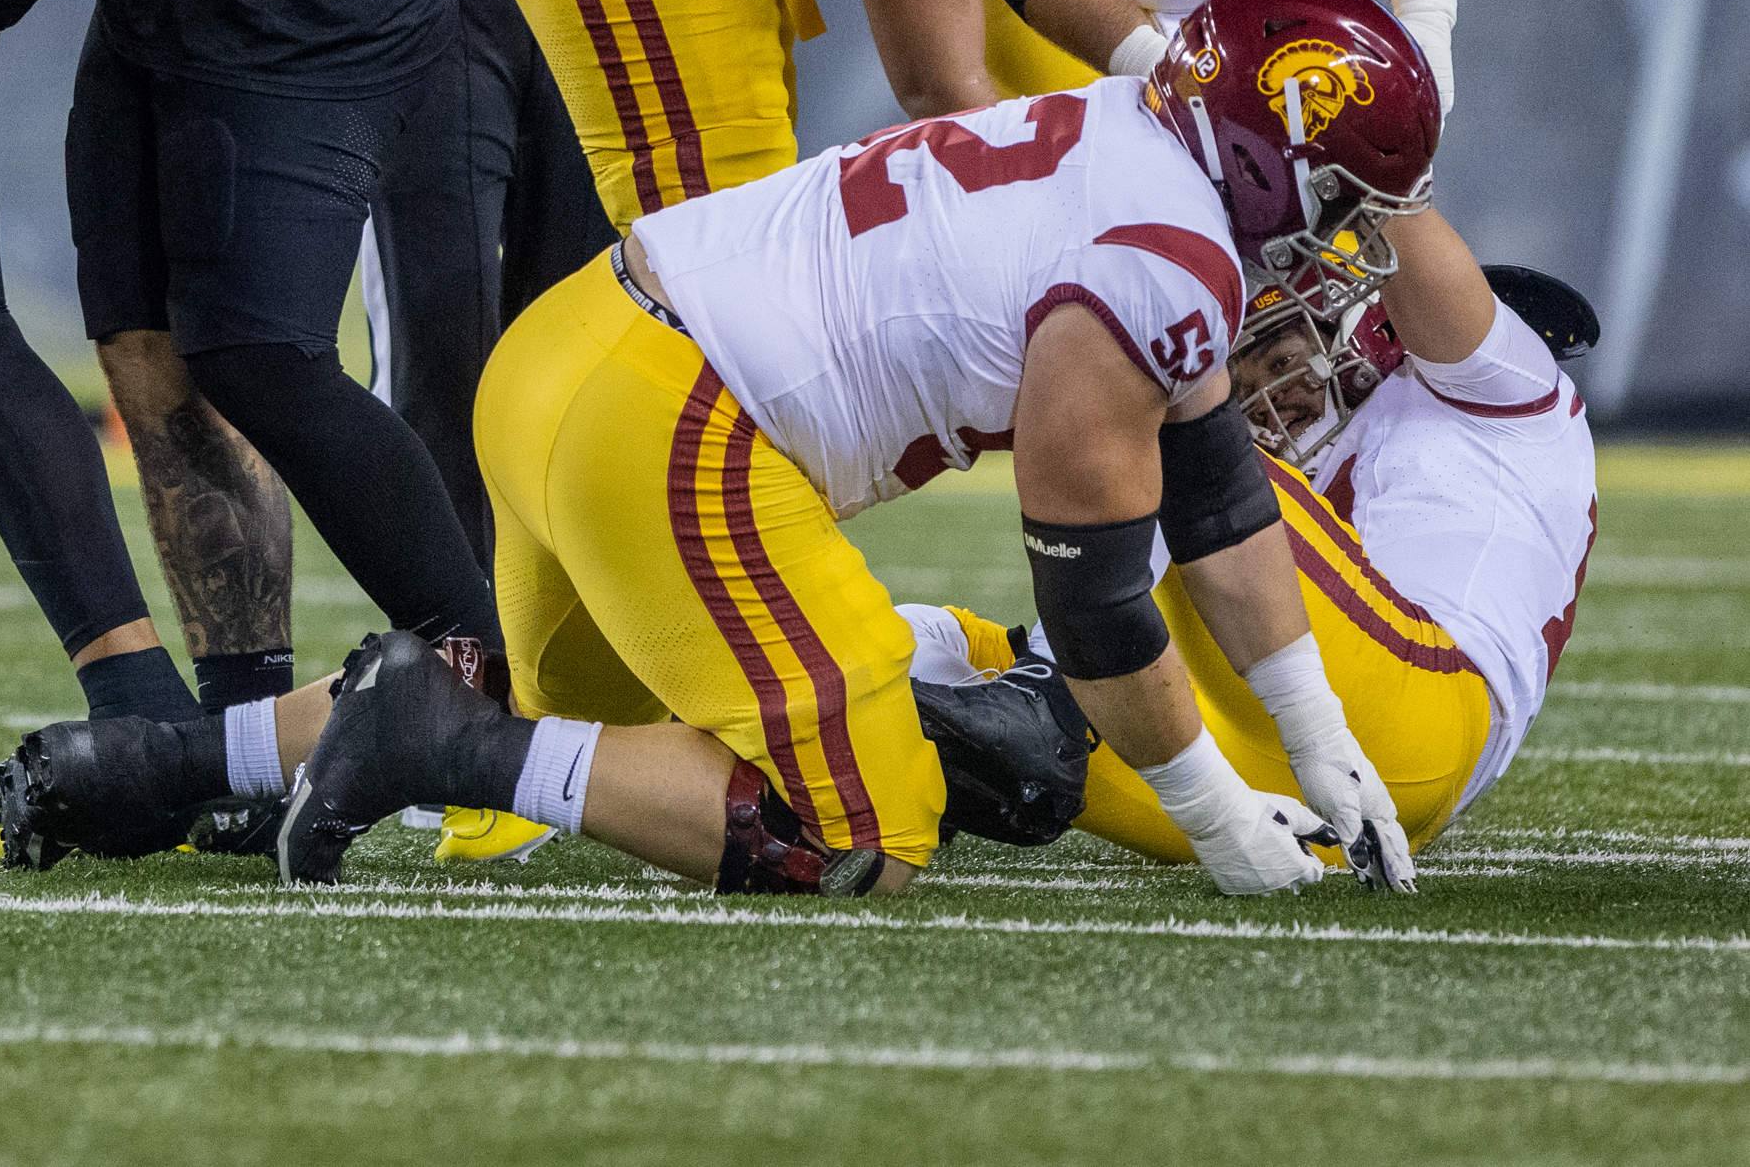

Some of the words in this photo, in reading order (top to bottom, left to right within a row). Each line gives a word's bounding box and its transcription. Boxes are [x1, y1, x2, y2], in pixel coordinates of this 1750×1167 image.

[1197, 52, 1216, 78] 12
[1253, 290, 1282, 309] USC
[1150, 308, 1214, 382] 52
[1035, 538, 1082, 559] Mueller
[264, 654, 295, 664] NIKE
